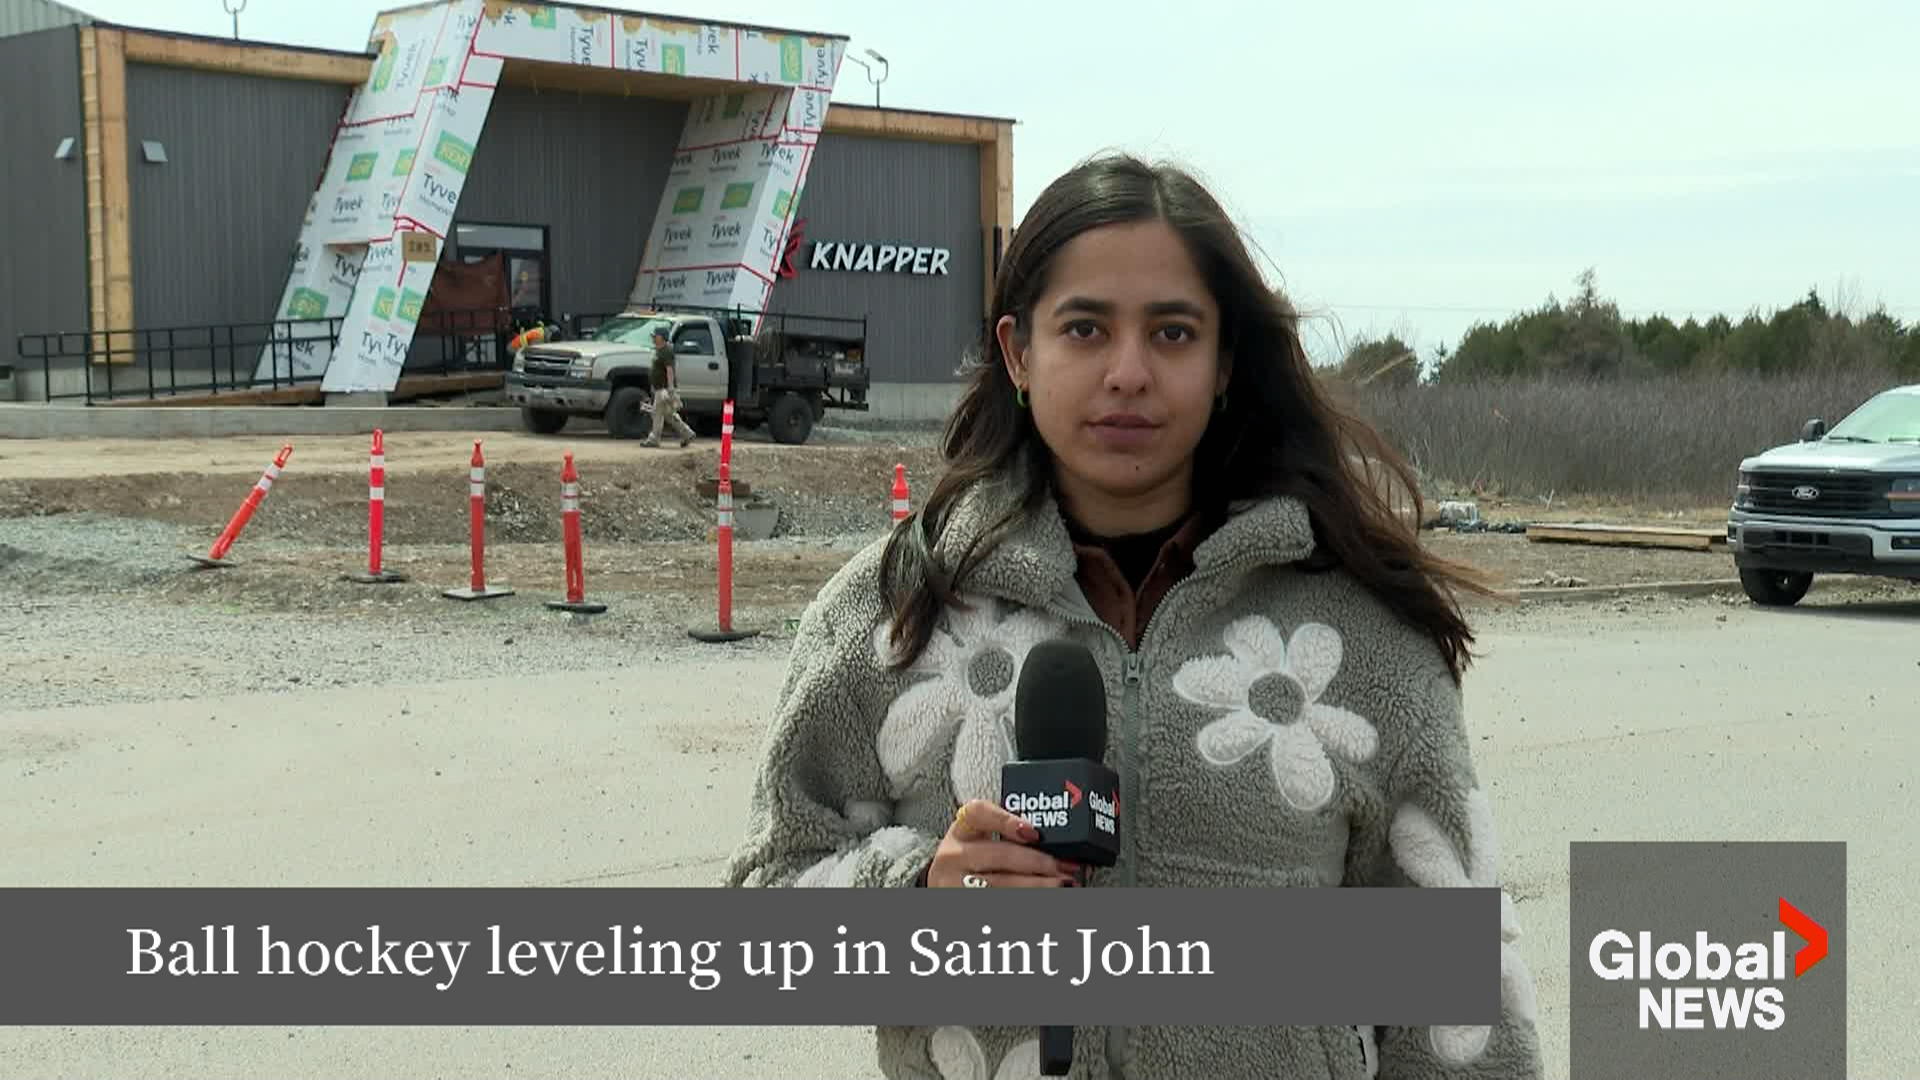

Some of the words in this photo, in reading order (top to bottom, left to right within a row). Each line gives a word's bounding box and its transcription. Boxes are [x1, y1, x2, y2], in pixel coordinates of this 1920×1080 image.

[335, 196, 363, 214] Tyvek
[664, 227, 692, 242] Tyvek
[711, 222, 742, 239] Tyvek
[811, 240, 950, 275] KNAPPER
[657, 274, 687, 291] Tyvek
[706, 269, 737, 287] Tyvek
[1005, 790, 1069, 812] Global
[1089, 790, 1115, 818] Global
[1095, 813, 1115, 835] NEWS
